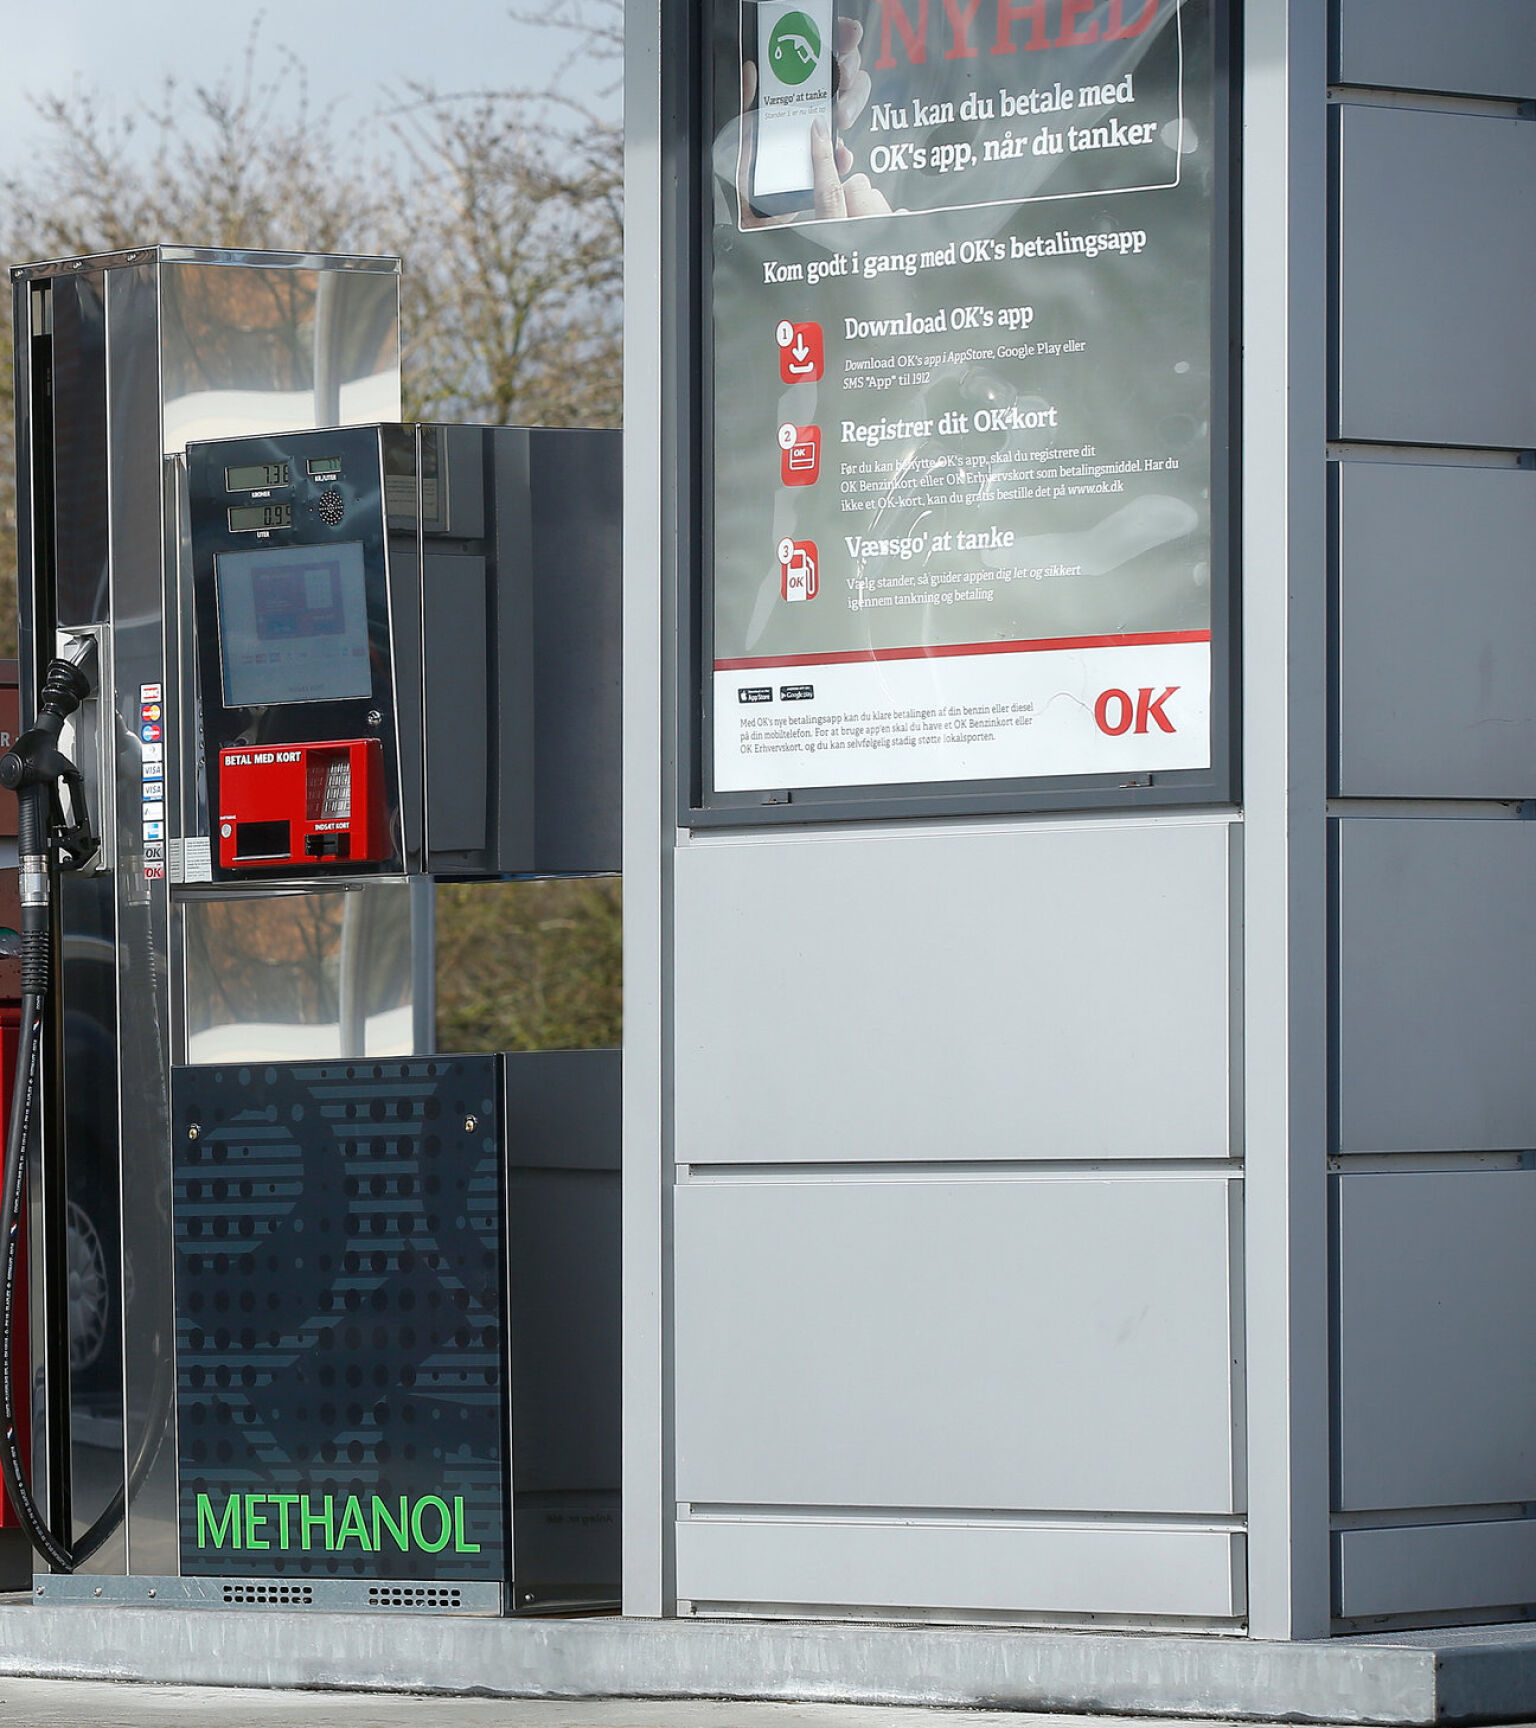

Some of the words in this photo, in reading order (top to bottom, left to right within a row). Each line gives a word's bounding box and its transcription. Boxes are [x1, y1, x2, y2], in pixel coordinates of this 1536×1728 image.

[796, 94, 804, 102] at
[806, 90, 827, 100] tanke
[870, 104, 907, 131] Nu
[914, 97, 954, 126] kan
[960, 92, 993, 121] du
[999, 82, 1072, 117] betale
[1078, 74, 1134, 108] med
[870, 140, 926, 172] OK's
[930, 144, 976, 173] app,
[983, 131, 1027, 160] når
[1032, 126, 1063, 155] du
[1067, 118, 1156, 152] tanker
[763, 261, 803, 282] Kom
[807, 253, 847, 284] godt
[852, 252, 859, 274] i
[863, 254, 916, 278] gang
[920, 242, 955, 268] med
[959, 238, 1005, 264] OK's
[1009, 232, 1146, 260] betalingsapp
[844, 308, 946, 339] Download
[950, 305, 992, 330] OK's
[998, 307, 1032, 330] app
[844, 353, 894, 370] Download
[897, 352, 921, 366] OK's
[924, 354, 940, 367] app
[947, 348, 994, 365] AppStore,
[997, 342, 1034, 360] Google
[1037, 340, 1061, 356] Play
[1062, 338, 1085, 352] eller
[842, 375, 863, 389] SMS
[898, 371, 910, 385] til
[912, 370, 929, 384] 1912
[784, 430, 791, 443] 2
[841, 417, 933, 446] Registrer
[938, 412, 967, 435] dit
[974, 406, 1057, 432] OK-kort
[794, 448, 806, 457] OK
[840, 462, 855, 474] Før
[858, 459, 872, 473] du
[874, 458, 892, 472] kan
[938, 453, 962, 467] OK's
[990, 449, 1011, 463] skal
[1014, 448, 1028, 462] du
[1030, 446, 1079, 463] registrere
[1081, 443, 1095, 457] dit
[840, 479, 856, 492] OK
[860, 475, 917, 491] Benzinkort
[920, 473, 943, 487] eller
[946, 472, 963, 485] OK
[1036, 468, 1056, 478] som
[1144, 458, 1164, 470] Har
[1165, 456, 1178, 469] du
[841, 497, 862, 511] ikke
[865, 498, 875, 509] et
[927, 492, 947, 505] kan
[949, 490, 963, 504] du
[997, 485, 1032, 500] bestille
[1034, 484, 1050, 498] det
[1053, 483, 1065, 500] på
[1067, 478, 1123, 495] www.ok.dk
[783, 545, 790, 558] 3
[844, 529, 927, 559] Værsgo'
[931, 532, 952, 551] at
[956, 524, 1013, 550] tanke
[789, 576, 804, 588] OK
[846, 575, 875, 591] Vælg
[917, 572, 929, 585] så
[930, 570, 961, 587] guider
[996, 567, 1011, 583] dig
[1013, 566, 1027, 579] let
[1029, 568, 1042, 581] og
[1044, 563, 1081, 577] sikkert
[847, 595, 892, 611] igennem
[894, 590, 939, 606] tankning
[941, 592, 952, 605] og
[954, 586, 993, 602] betaling
[740, 716, 755, 727] Med
[756, 715, 772, 726] OK's
[774, 717, 786, 728] nye
[788, 713, 842, 725] betalingsapp
[843, 711, 858, 721] kan
[860, 710, 870, 720] du
[872, 709, 891, 720] klare
[893, 708, 935, 720] betalingen
[938, 706, 947, 716] af
[948, 705, 960, 716] din
[963, 704, 989, 715] benzin
[991, 703, 1008, 713] eller
[1011, 701, 1033, 712] diesel
[1094, 686, 1181, 736] OK
[146, 766, 161, 774] VISA
[225, 755, 252, 766] BETAL
[254, 753, 274, 764] MED
[276, 751, 301, 762] KORT
[146, 785, 161, 794] VISA
[146, 848, 161, 858] OK
[146, 868, 161, 878] OK
[196, 1493, 481, 1553] METHANOL
